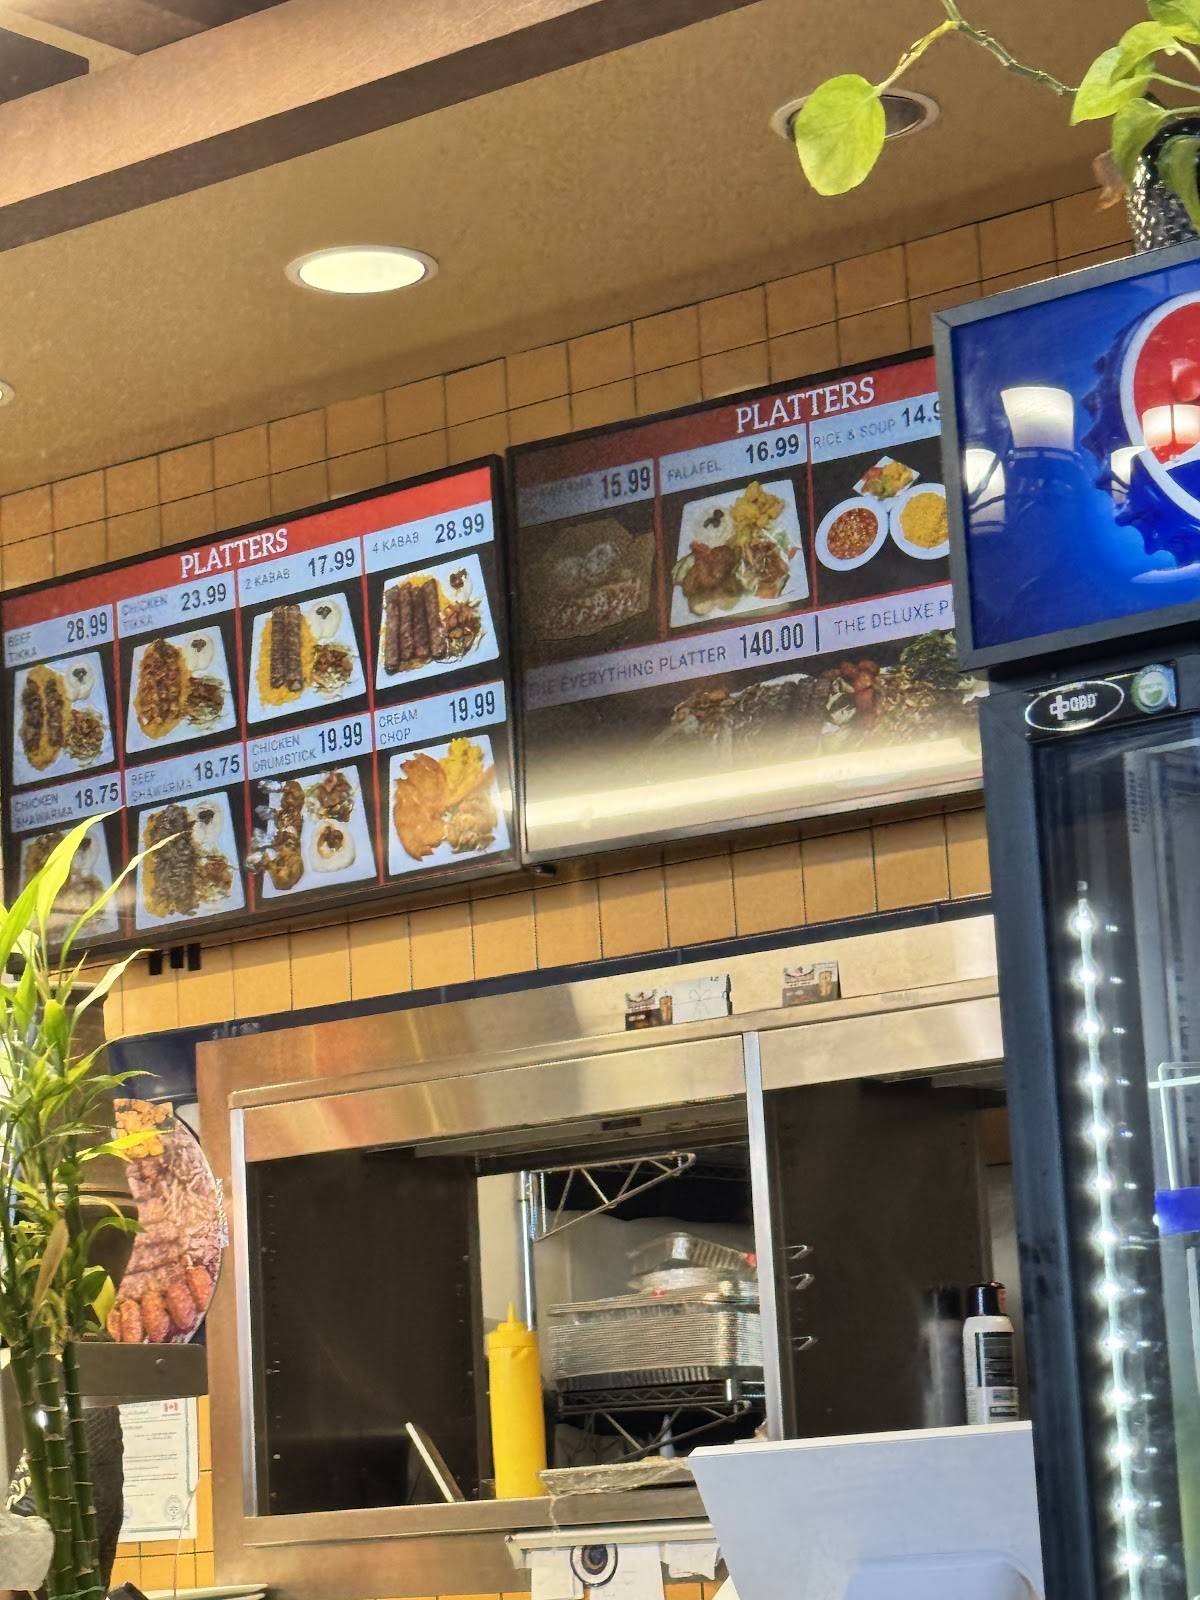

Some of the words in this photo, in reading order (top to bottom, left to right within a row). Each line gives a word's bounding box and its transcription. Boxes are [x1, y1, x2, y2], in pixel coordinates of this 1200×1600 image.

[735, 376, 875, 435] PLATTERS
[813, 431, 843, 448] RICE
[847, 431, 855, 441] &
[860, 418, 896, 436] SOUP
[667, 460, 722, 481] FALAFEL
[745, 433, 800, 464] 16.99
[600, 466, 651, 500] 15.99
[371, 542, 378, 554] 4
[382, 532, 420, 552] KABAB
[435, 513, 485, 544] 28.99
[179, 528, 288, 579] PLATTERS
[245, 578, 252, 590] 2
[254, 568, 290, 585] KABAB
[308, 548, 355, 577] 17.99
[181, 582, 227, 612] 23.99
[66, 611, 108, 643] 28.99
[834, 614, 866, 636] THE
[872, 601, 934, 629] DELUXE
[560, 660, 654, 692] EVERYTHING
[659, 645, 726, 673] PLATTER
[739, 622, 804, 659] 140.00
[378, 708, 418, 728] CREAM
[449, 690, 496, 724] 19.99
[252, 735, 300, 756] CHICKEN
[318, 721, 363, 754] 19.99
[379, 727, 411, 745] CHOP
[131, 770, 156, 786] BEEF
[194, 754, 240, 781] 18.75
[252, 749, 317, 773] DRUMSTICK
[75, 782, 119, 808] 18.75
